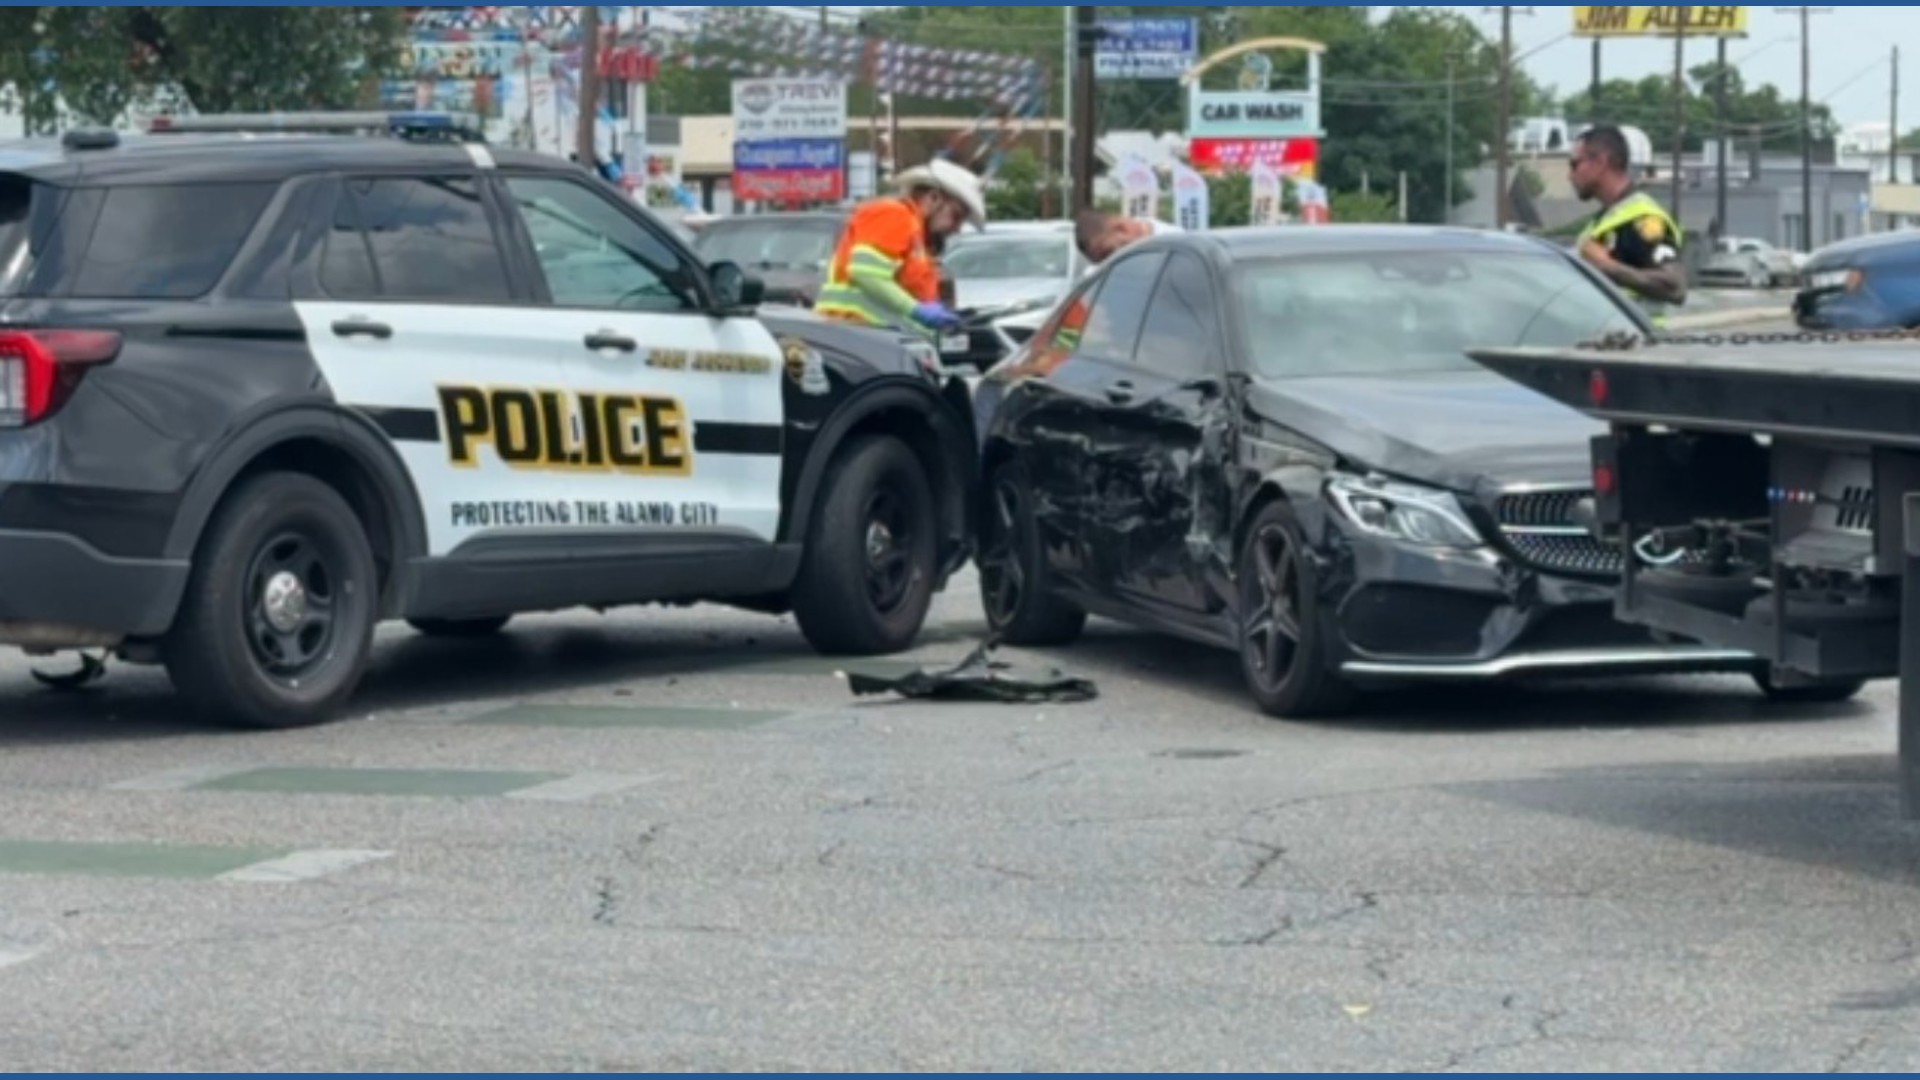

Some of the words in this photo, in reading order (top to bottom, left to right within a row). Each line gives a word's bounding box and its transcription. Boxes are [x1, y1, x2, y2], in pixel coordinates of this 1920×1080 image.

[1575, 6, 1630, 30] JIM
[776, 83, 839, 99] TREVI
[1202, 104, 1240, 121] CAR
[1246, 104, 1304, 122] WASH
[436, 384, 693, 476] POLICE
[451, 500, 570, 527] PROTECTING
[574, 501, 610, 524] THE
[615, 501, 675, 525] ALAMO
[681, 502, 719, 526] CITY
